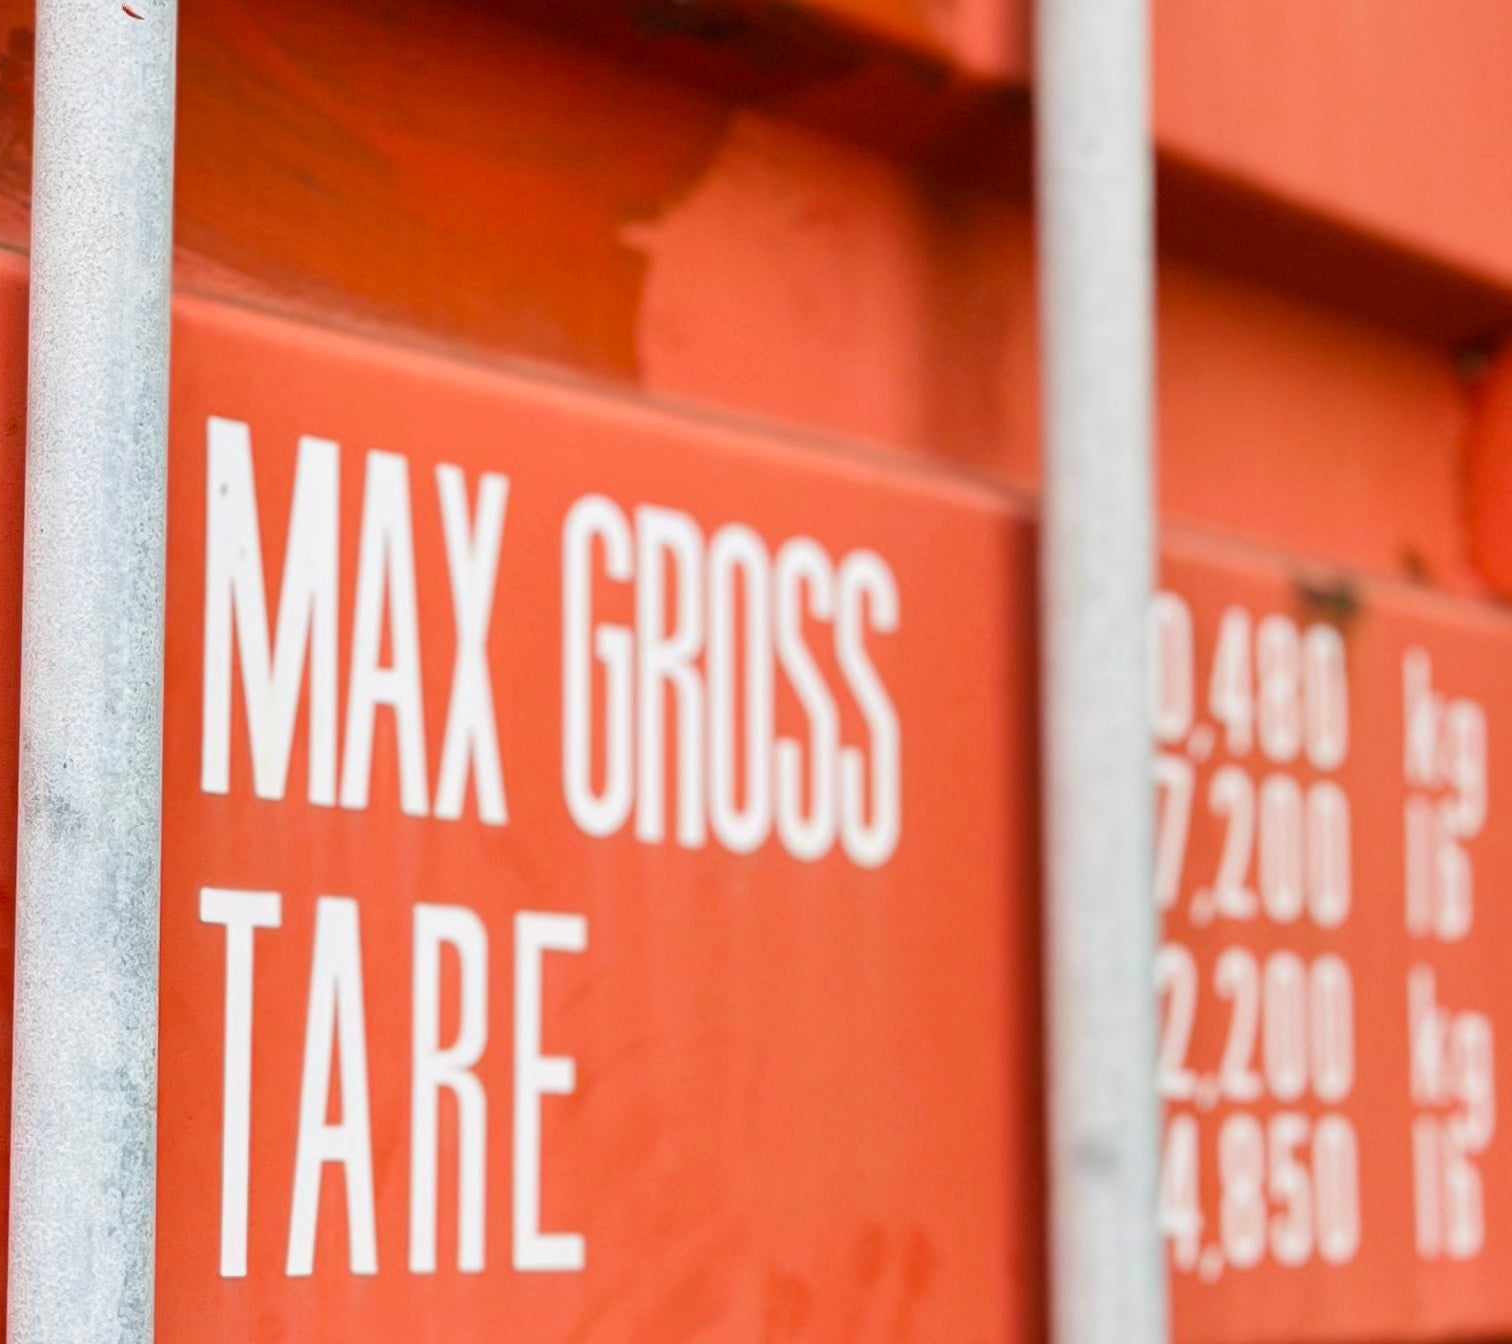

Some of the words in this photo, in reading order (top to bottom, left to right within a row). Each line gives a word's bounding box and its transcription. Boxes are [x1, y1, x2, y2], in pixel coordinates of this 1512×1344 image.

[201, 416, 509, 825] MAX
[562, 494, 900, 868] GROSS
[199, 887, 588, 1278] TARE
